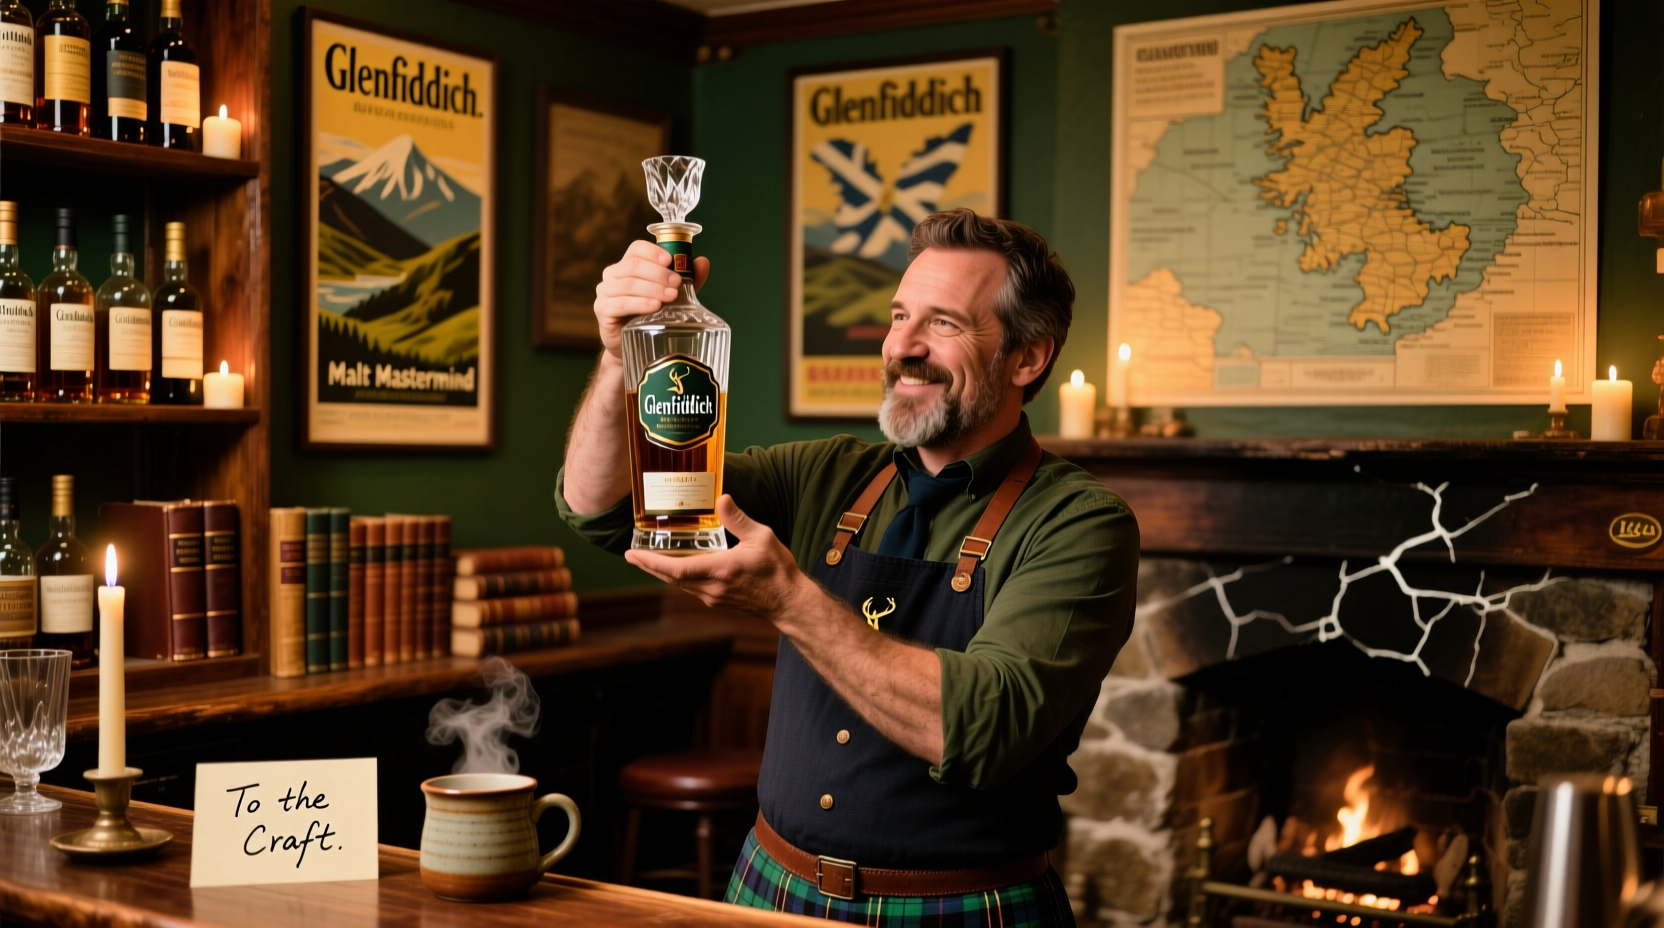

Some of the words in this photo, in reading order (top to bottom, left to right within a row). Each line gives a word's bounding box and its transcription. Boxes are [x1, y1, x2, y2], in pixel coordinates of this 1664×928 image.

[325, 43, 484, 118] Glenfiddich.
[810, 75, 982, 127] Glenfiddich
[328, 360, 372, 387] Malt
[375, 363, 476, 392] Mastermind
[226, 783, 261, 818] To
[278, 780, 330, 812] the
[243, 820, 343, 869] Craft.
